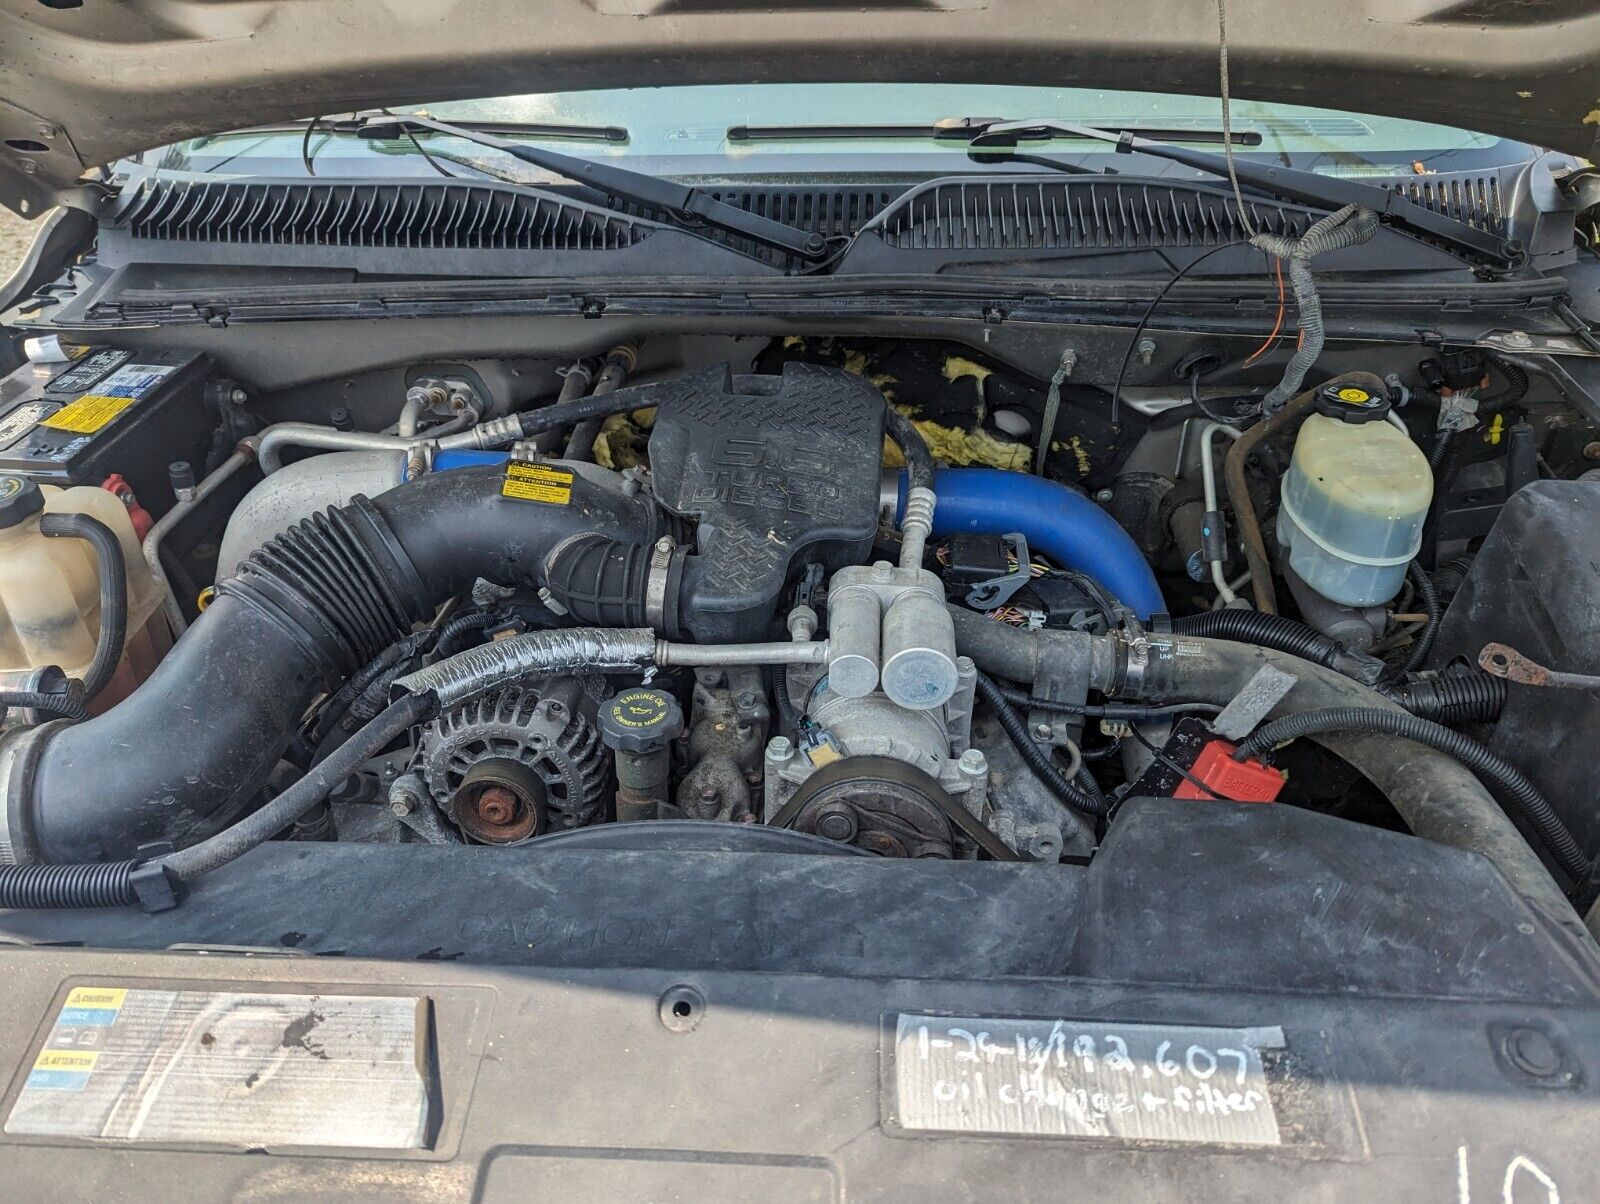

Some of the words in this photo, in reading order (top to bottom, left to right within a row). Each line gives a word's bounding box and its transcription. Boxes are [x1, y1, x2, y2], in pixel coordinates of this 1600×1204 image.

[522, 463, 553, 471] CAUTION
[519, 477, 558, 487] ATTENTION
[620, 693, 656, 704] ENGINE
